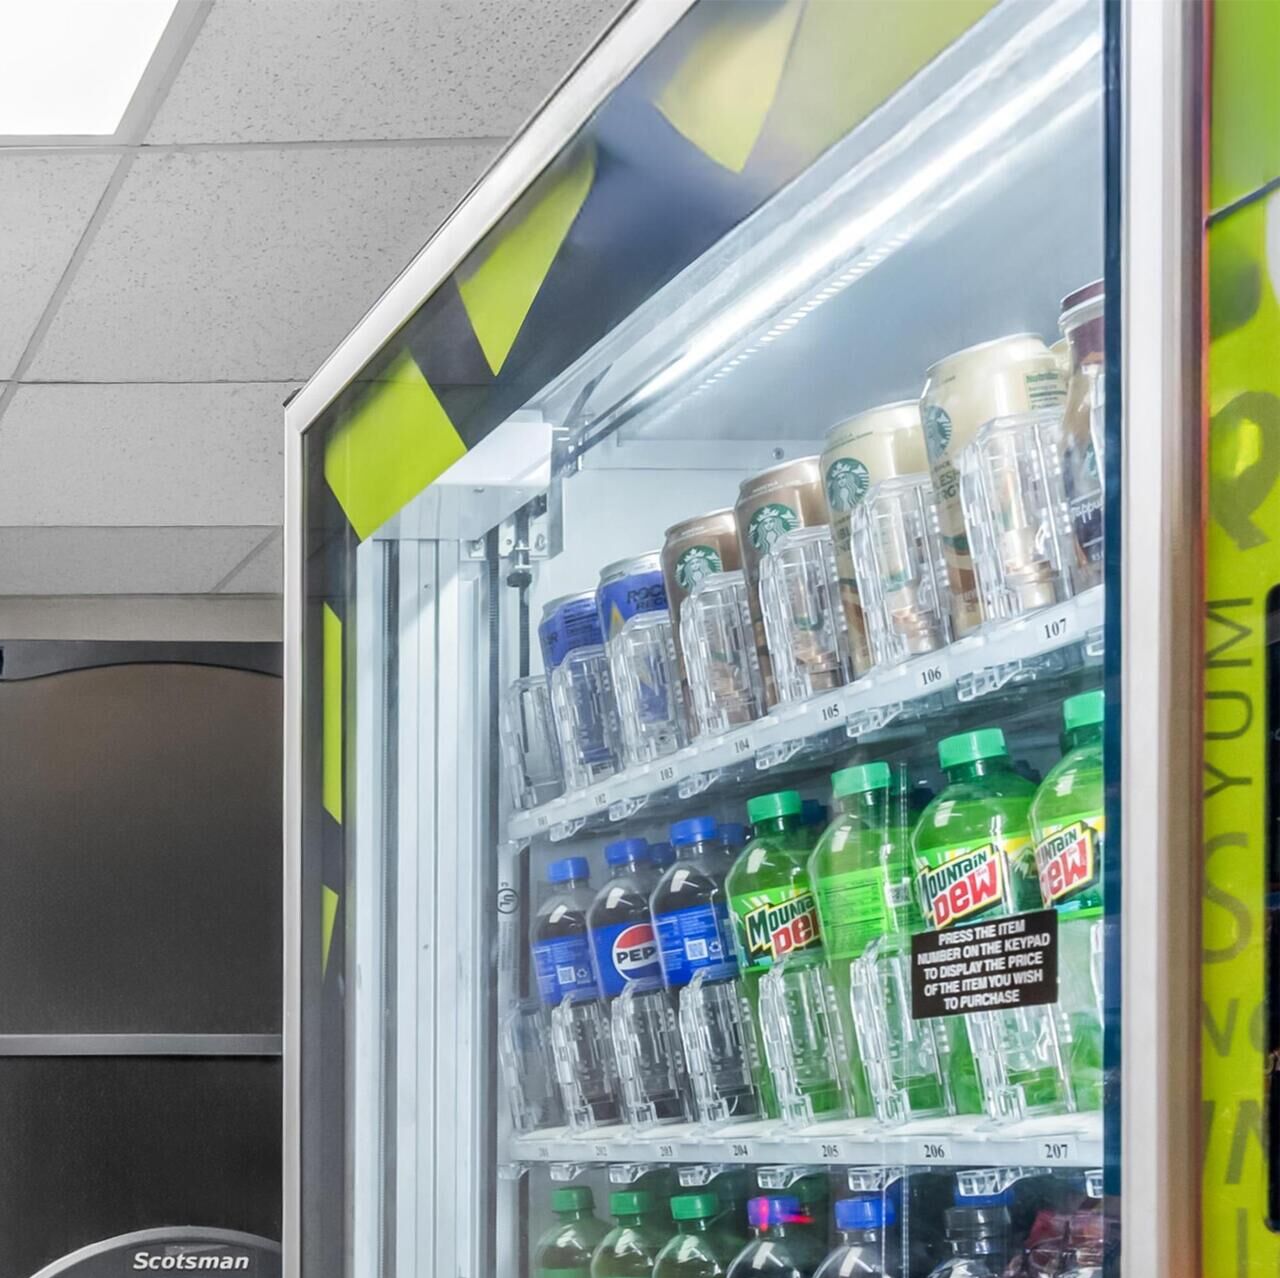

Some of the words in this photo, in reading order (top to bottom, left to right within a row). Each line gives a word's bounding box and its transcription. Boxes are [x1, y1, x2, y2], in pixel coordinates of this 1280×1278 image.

[627, 584, 663, 604] ROC
[1044, 617, 1067, 640] 107
[921, 665, 942, 686] 106
[822, 703, 840, 721] 105
[734, 738, 750, 754] 104
[938, 928, 974, 946] PRESS
[975, 923, 997, 940] THE
[998, 918, 1026, 936] ITEM
[615, 945, 657, 964] PEP
[917, 947, 962, 966] NUMBER
[963, 944, 981, 960] ON
[981, 941, 1003, 957] THE
[1004, 933, 1051, 952] KEYPAD
[924, 967, 938, 981] TO
[940, 961, 984, 979] DISPLAY
[985, 957, 1006, 973] THE
[1008, 951, 1043, 969] PRICE
[924, 983, 939, 997] OF
[940, 979, 961, 994] THE
[961, 975, 988, 992] ITEM
[989, 972, 1012, 988] YOU
[1013, 968, 1043, 985] WISH
[944, 996, 958, 1011] TO
[960, 988, 1020, 1010] PURCHASE
[822, 1144, 840, 1158] 205
[924, 1144, 945, 1158] 206
[1045, 1143, 1068, 1159] 207
[132, 1251, 250, 1271] Scotsman
